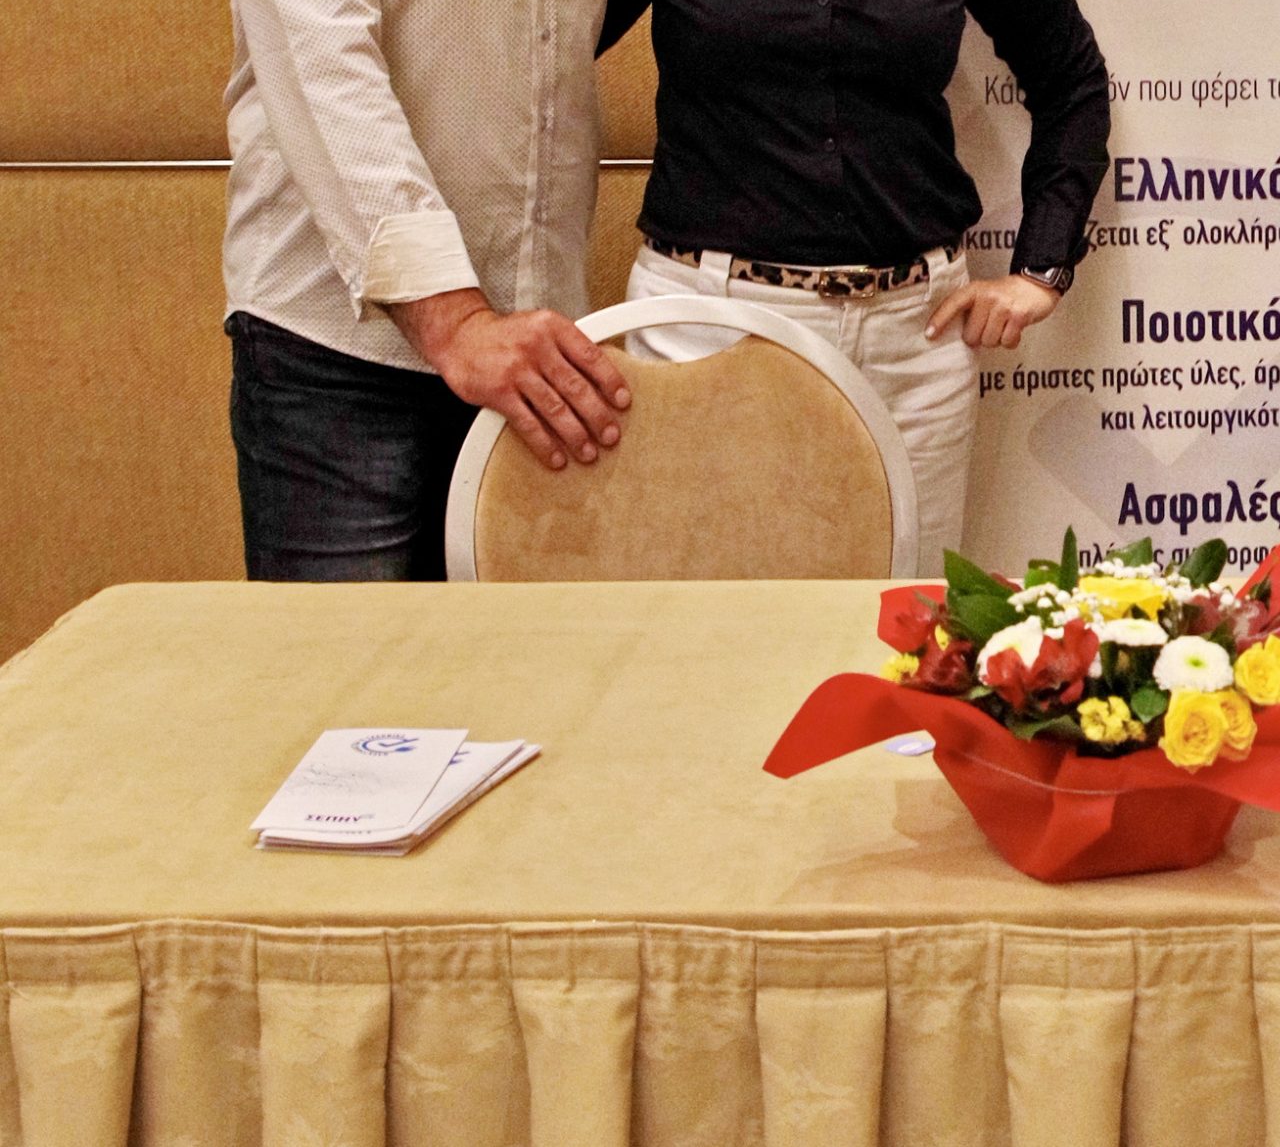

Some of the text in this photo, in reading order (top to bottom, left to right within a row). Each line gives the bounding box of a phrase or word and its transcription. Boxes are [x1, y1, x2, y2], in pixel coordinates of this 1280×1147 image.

[1139, 80, 1182, 101] που
[1191, 72, 1258, 107] φέρει
[979, 370, 1006, 395] με
[1012, 367, 1094, 392] άριστες
[1102, 363, 1183, 392] πρώτες
[1190, 360, 1245, 388] ύλες,
[1101, 409, 1135, 430] και
